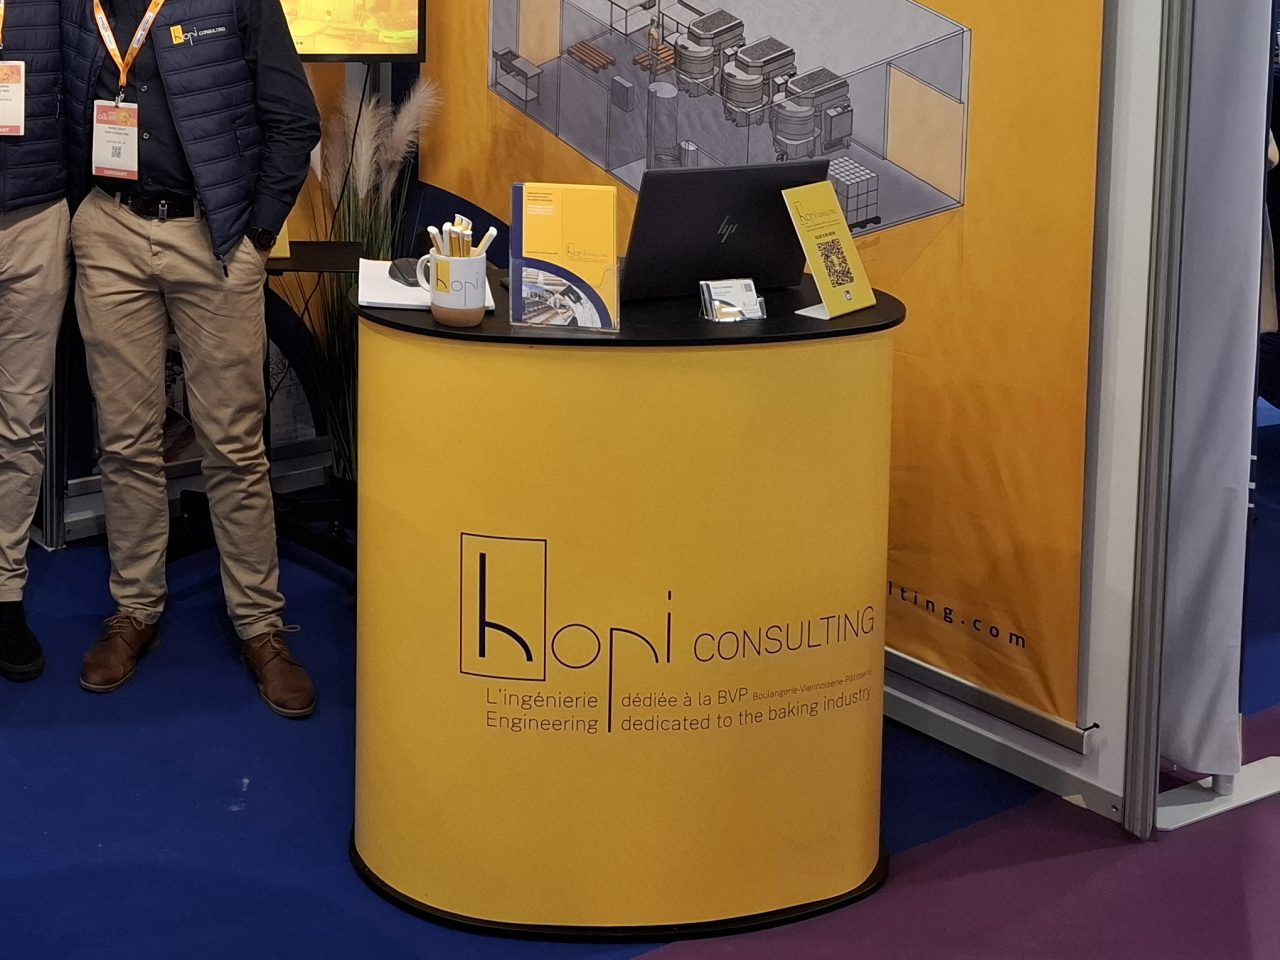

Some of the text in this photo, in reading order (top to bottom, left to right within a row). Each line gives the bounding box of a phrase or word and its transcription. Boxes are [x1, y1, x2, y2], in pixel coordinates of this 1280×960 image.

[478, 552, 875, 733] hopi CONSULTING
[485, 687, 599, 711] L'ingénierie
[621, 691, 678, 708] dédiée
[683, 691, 693, 708] à
[698, 690, 712, 707] la
[717, 686, 748, 705] BVP
[485, 686, 872, 735] Engineering dedicated to the baking industry
